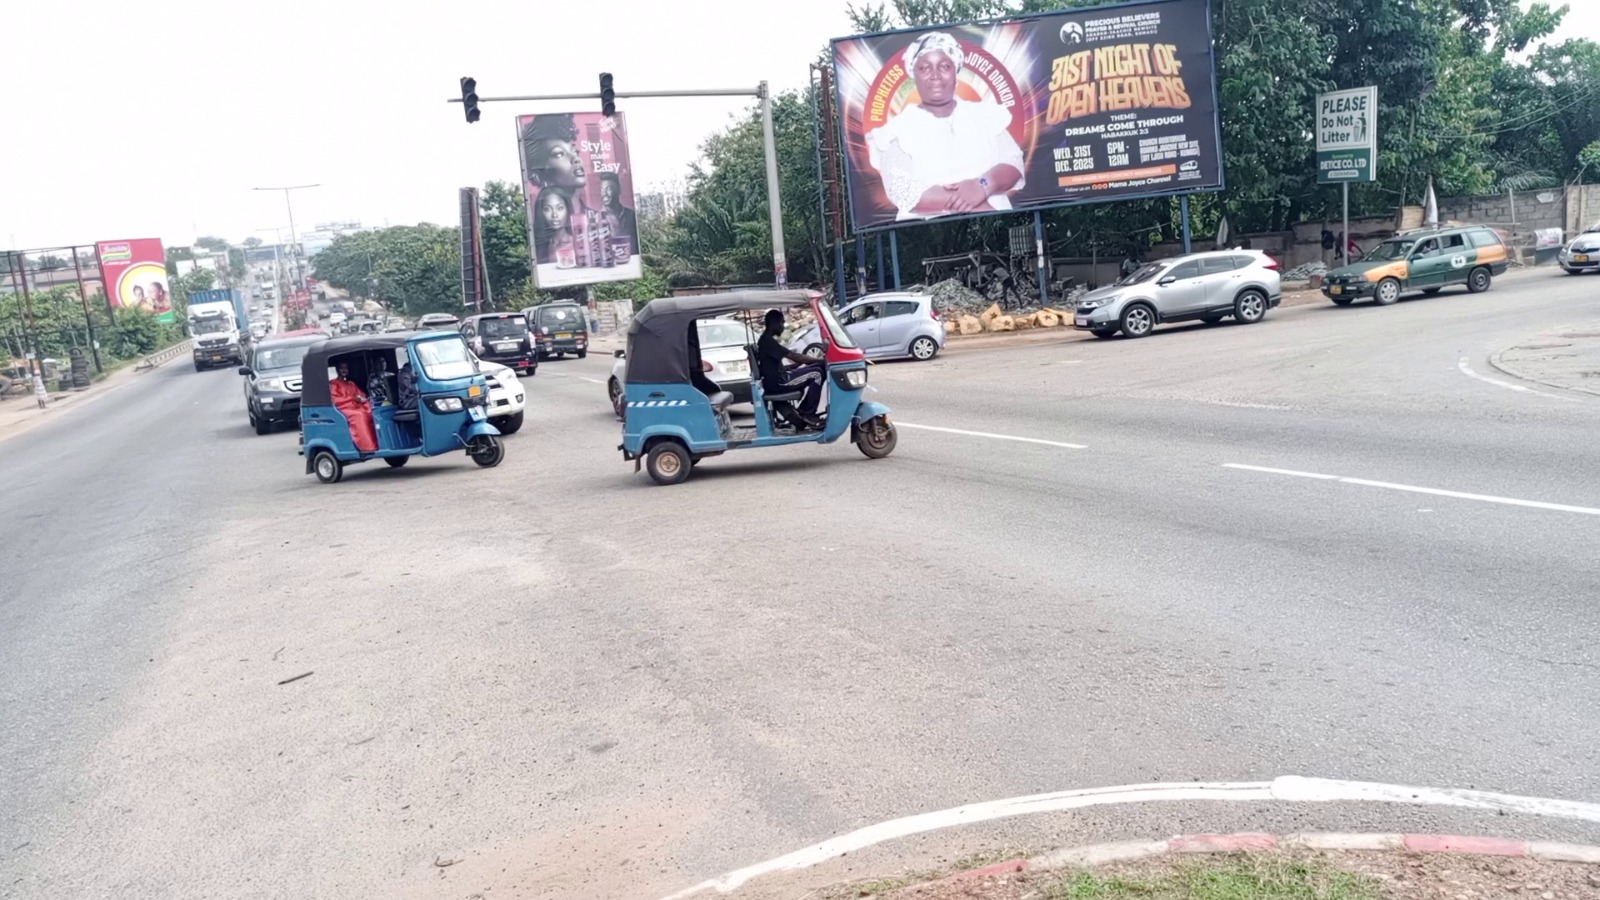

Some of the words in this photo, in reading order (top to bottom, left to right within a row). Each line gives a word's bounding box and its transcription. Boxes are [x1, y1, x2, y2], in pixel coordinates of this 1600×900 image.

[1085, 17, 1120, 27] PRECIOUS
[1121, 12, 1160, 22] BELIEVERS
[1049, 50, 1092, 91] 31ST
[1094, 43, 1152, 79] NIGHT
[1152, 43, 1183, 76] OF
[964, 51, 993, 76] JOYCE
[988, 69, 1015, 107] DONKOR
[870, 64, 904, 122] PROPHETESS
[1046, 82, 1098, 125] OPEN
[1099, 76, 1192, 111] HEAVENS
[1322, 95, 1367, 115] PLEASE
[1110, 113, 1137, 121] THEME:
[1322, 117, 1334, 128] Do
[1337, 115, 1354, 127] Not
[1065, 124, 1105, 136] DREAMS
[1107, 121, 1135, 131] COME
[1137, 115, 1184, 127] THROUGH
[1322, 131, 1350, 143] Litter
[581, 139, 611, 153] Style
[1054, 148, 1073, 160] WED.
[1074, 145, 1091, 158] 31ST
[1107, 141, 1124, 154] 6PM
[1055, 160, 1072, 173] DEC.
[1073, 158, 1094, 170] 2025
[1108, 154, 1129, 166] 12AM
[1355, 158, 1367, 168] LTD
[593, 161, 620, 174] Easy
[1128, 179, 1146, 187] Joyce
[1146, 175, 1171, 184] Channel
